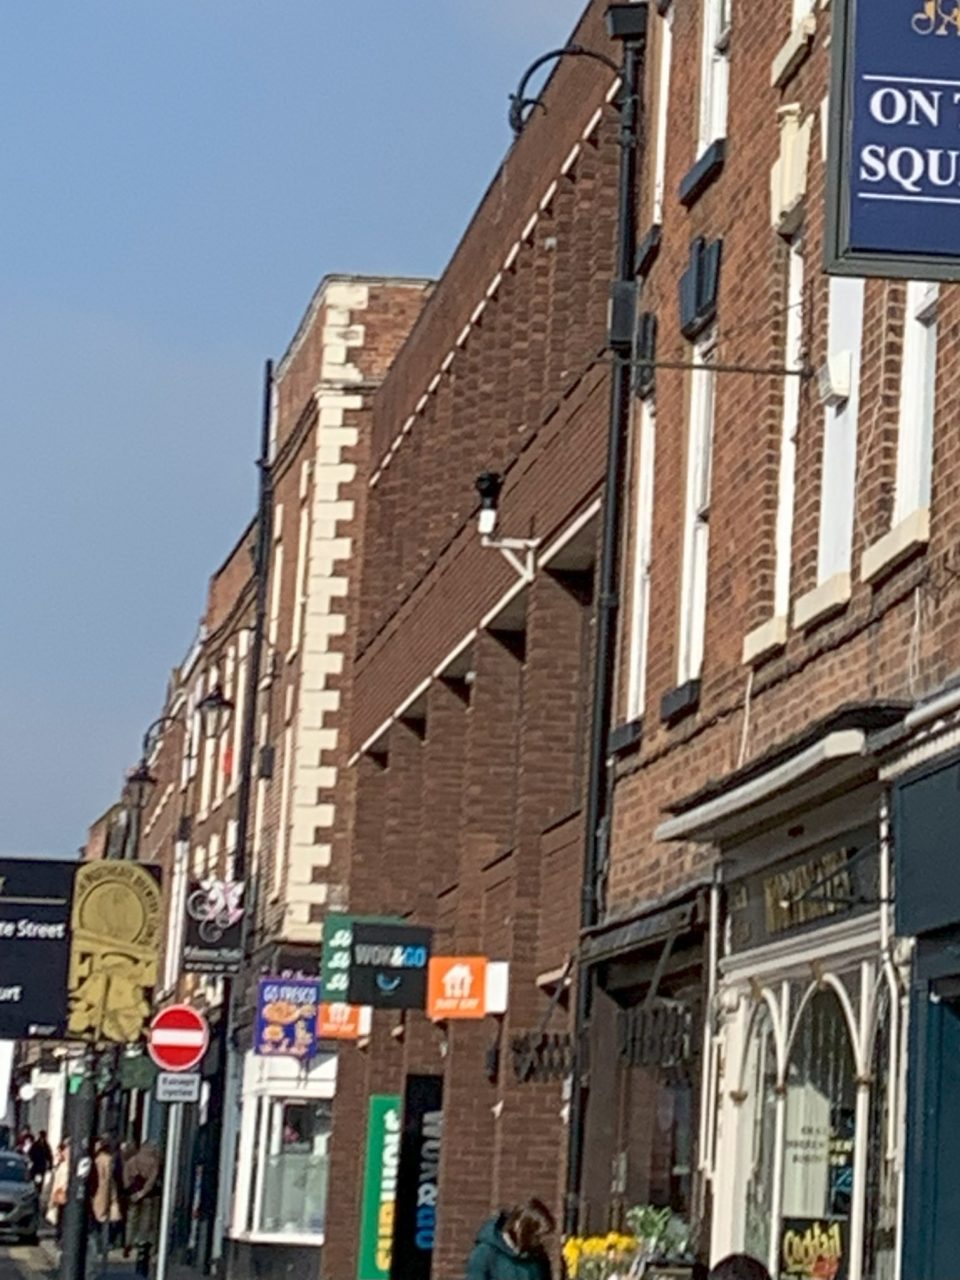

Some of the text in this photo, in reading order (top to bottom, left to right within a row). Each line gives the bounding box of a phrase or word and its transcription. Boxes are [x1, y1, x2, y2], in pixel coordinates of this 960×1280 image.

[869, 87, 942, 126] ON
[17, 918, 66, 938] Street
[354, 943, 427, 969] WOK&GO
